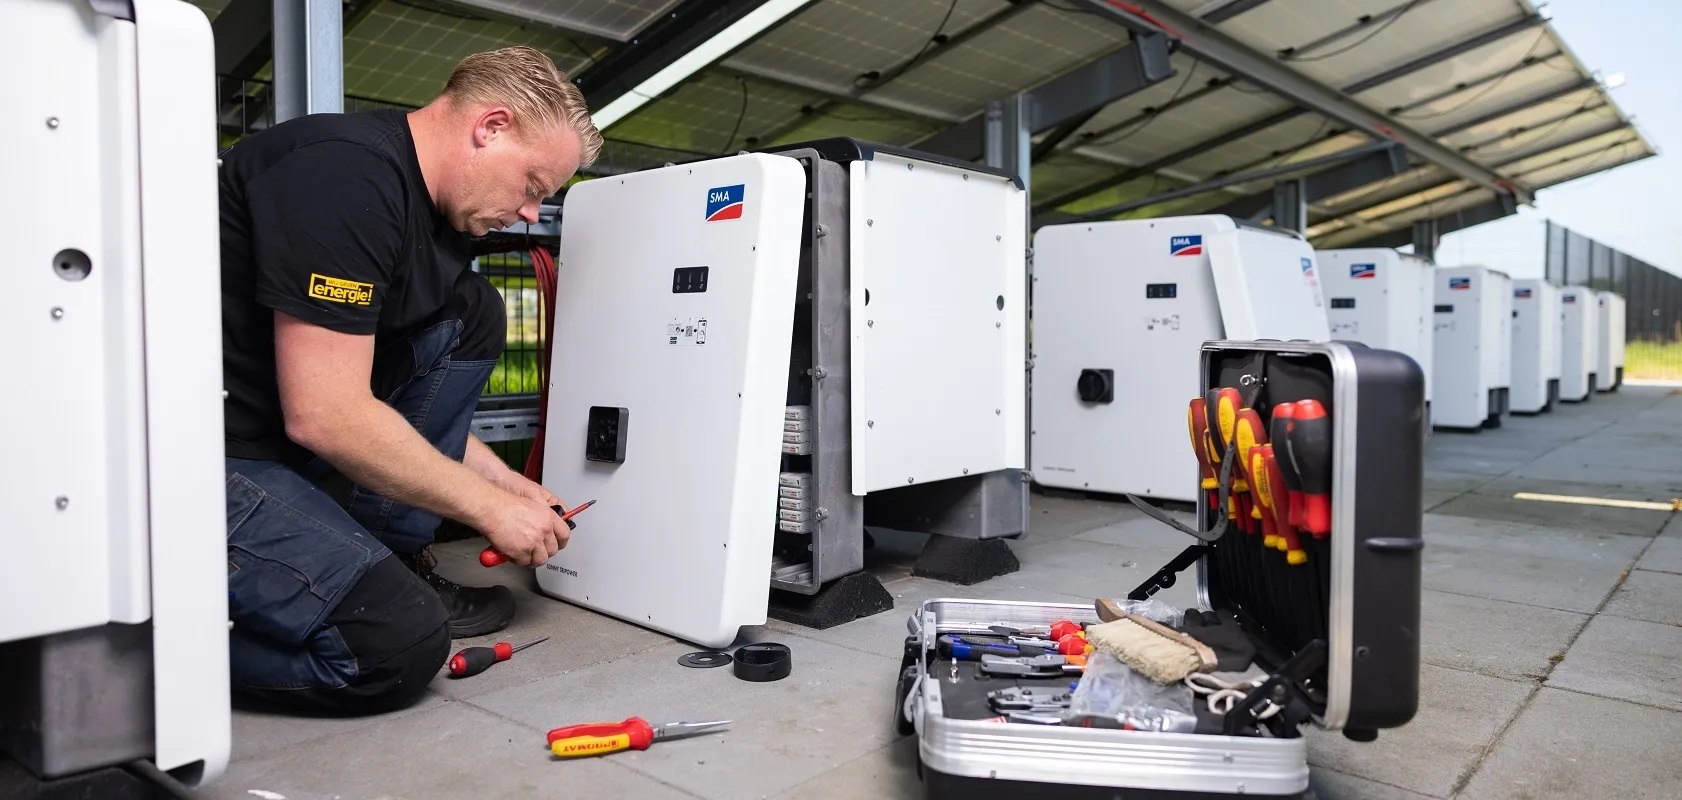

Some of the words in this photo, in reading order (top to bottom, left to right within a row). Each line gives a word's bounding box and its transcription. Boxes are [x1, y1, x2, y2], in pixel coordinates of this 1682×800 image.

[710, 191, 730, 204] SMA
[1172, 237, 1191, 246] SMA
[314, 284, 373, 304] energie!
